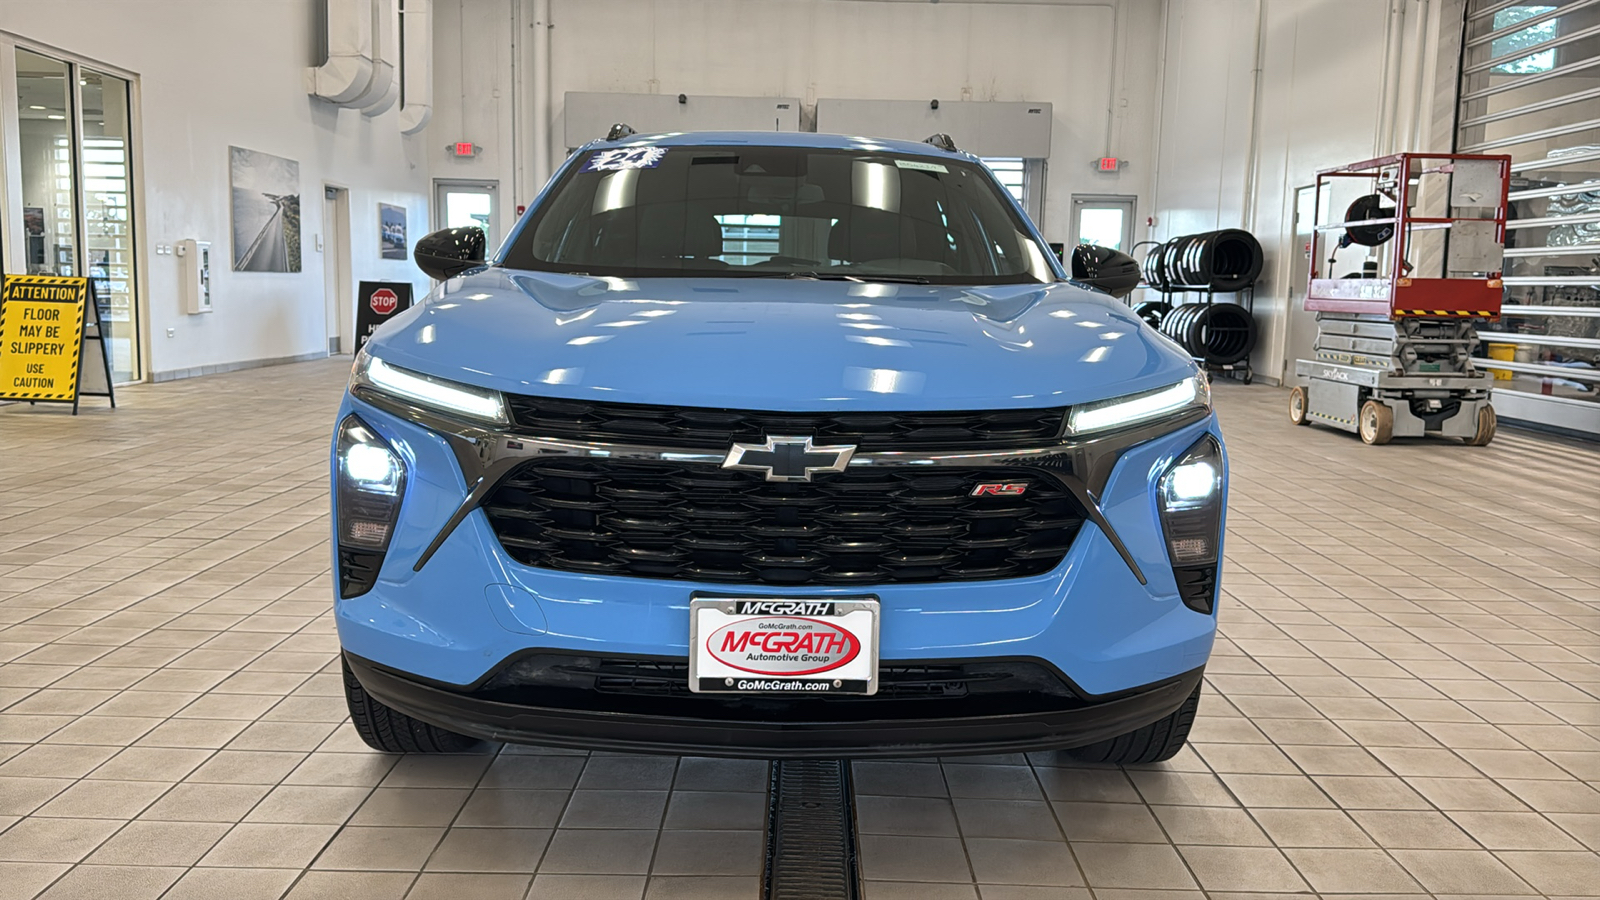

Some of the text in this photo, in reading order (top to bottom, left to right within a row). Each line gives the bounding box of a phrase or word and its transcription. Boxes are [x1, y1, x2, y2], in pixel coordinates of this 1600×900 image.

[602, 150, 648, 166] 24
[1101, 157, 1117, 170] EXIT
[12, 285, 76, 300] ATTENTION
[372, 296, 396, 307] STOP
[23, 308, 60, 321] FLOOR
[19, 325, 60, 338] MAY BE
[10, 342, 65, 355] SLIPPERY
[26, 363, 45, 374] USE
[1323, 368, 1348, 380] SKYJACK
[13, 377, 54, 388] CAUTION
[971, 483, 1028, 496] RS
[758, 622, 813, 631] GoMcGrath.com
[746, 652, 830, 664] Automotive Group
[737, 680, 830, 691] GoMcGrath.com
